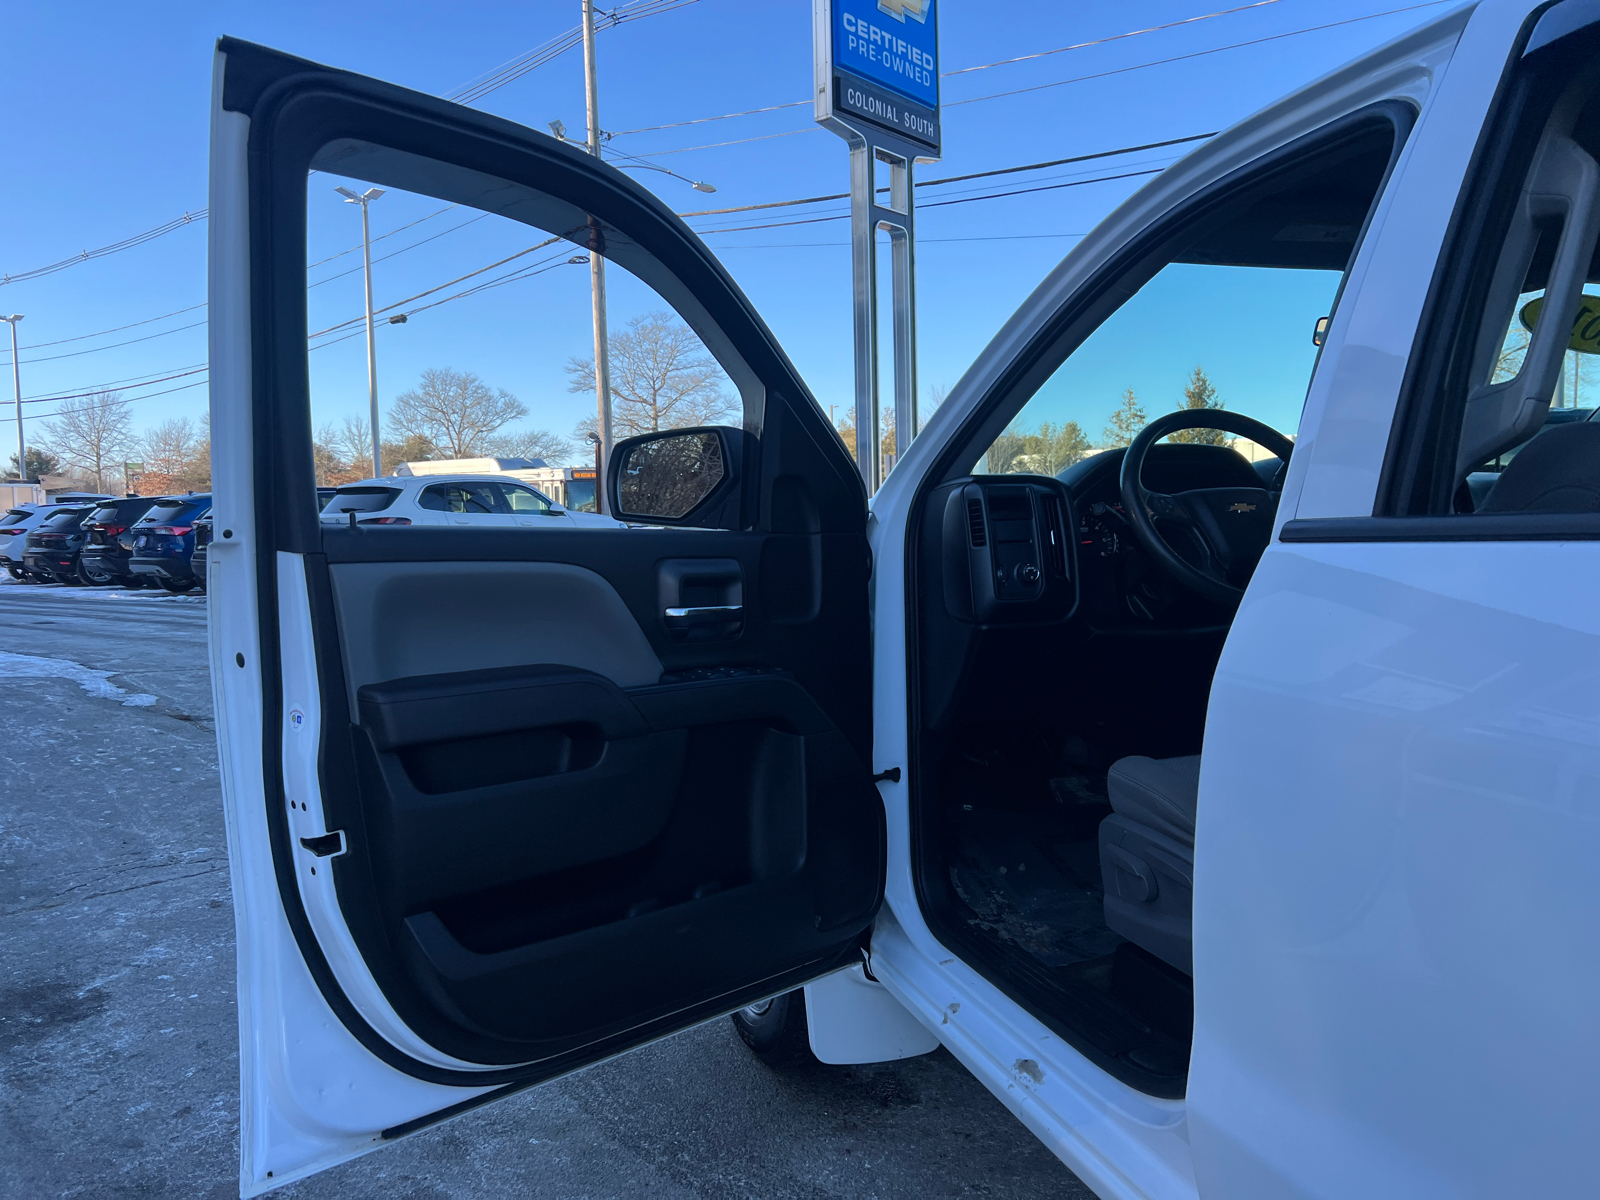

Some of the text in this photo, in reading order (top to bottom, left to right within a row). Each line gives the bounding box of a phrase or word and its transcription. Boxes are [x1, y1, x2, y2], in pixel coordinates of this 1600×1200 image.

[843, 12, 934, 71] CERTIFIED
[848, 34, 931, 87] PRE-OWNED
[847, 88, 934, 137] COLONIAL SOUTH
